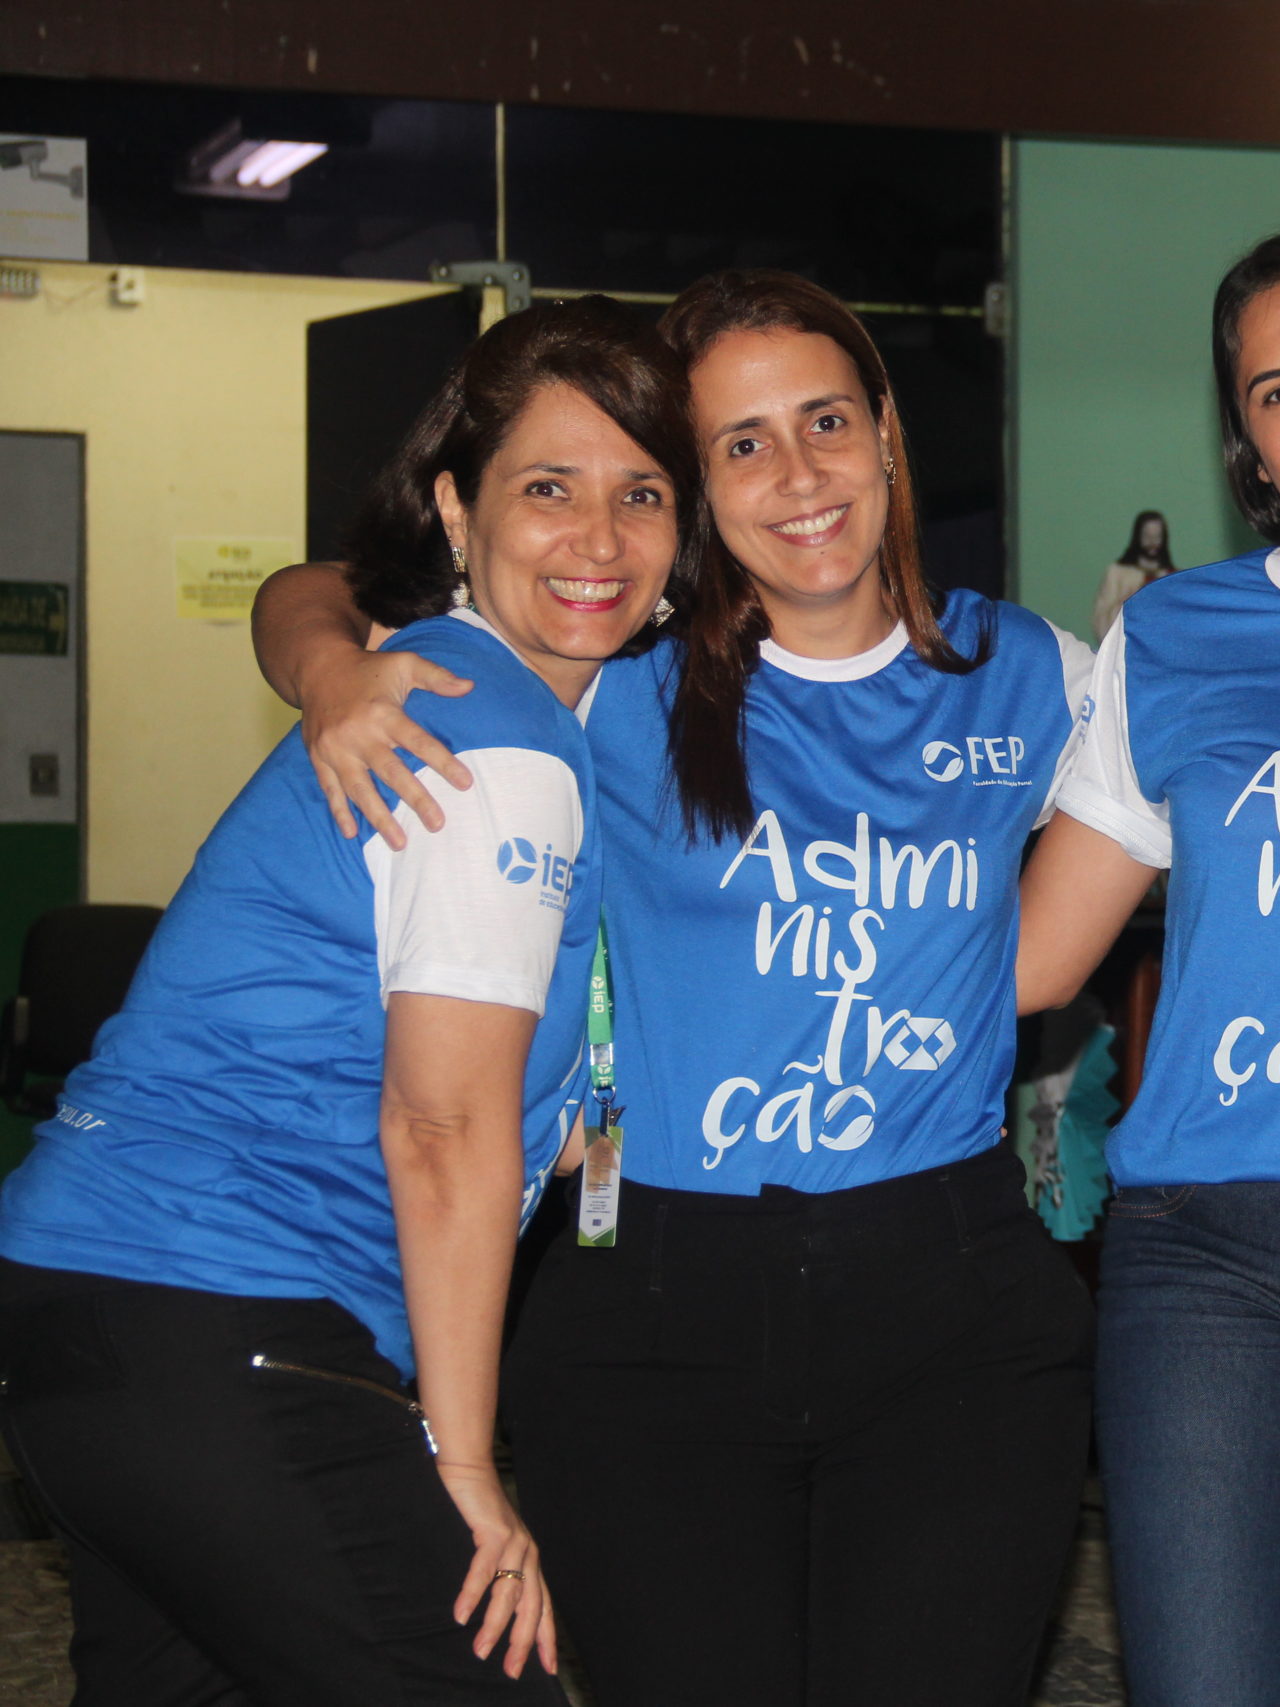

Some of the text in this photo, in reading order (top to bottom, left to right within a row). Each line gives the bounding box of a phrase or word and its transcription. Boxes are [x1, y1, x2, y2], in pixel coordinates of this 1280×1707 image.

[965, 736, 1025, 775] FEP
[719, 809, 979, 911] Admi
[754, 901, 885, 983] nis
